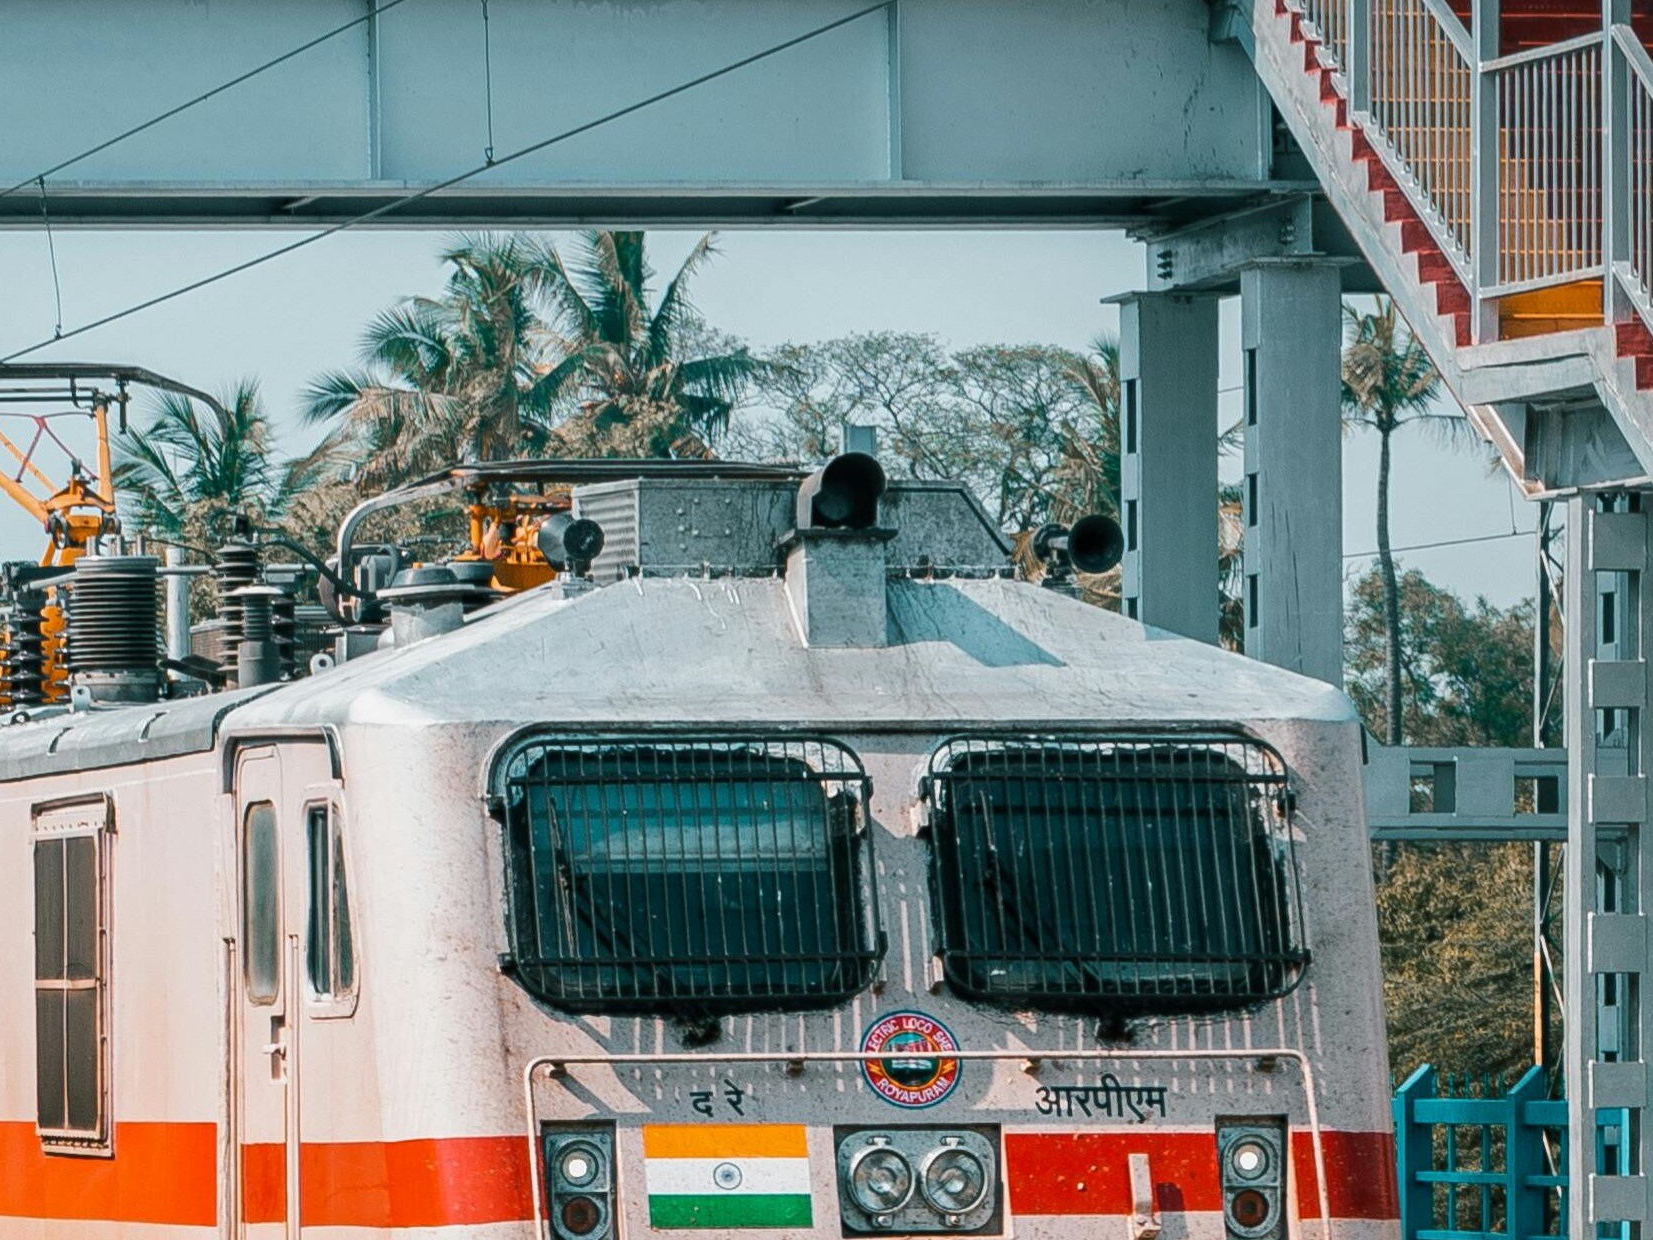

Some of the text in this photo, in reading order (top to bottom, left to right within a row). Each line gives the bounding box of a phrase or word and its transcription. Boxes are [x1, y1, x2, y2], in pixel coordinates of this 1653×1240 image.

[866, 1017, 954, 1054] LECTRIC LOCO SHE
[689, 1078, 745, 1118] द रे
[1035, 1073, 1168, 1122] आरपीएम
